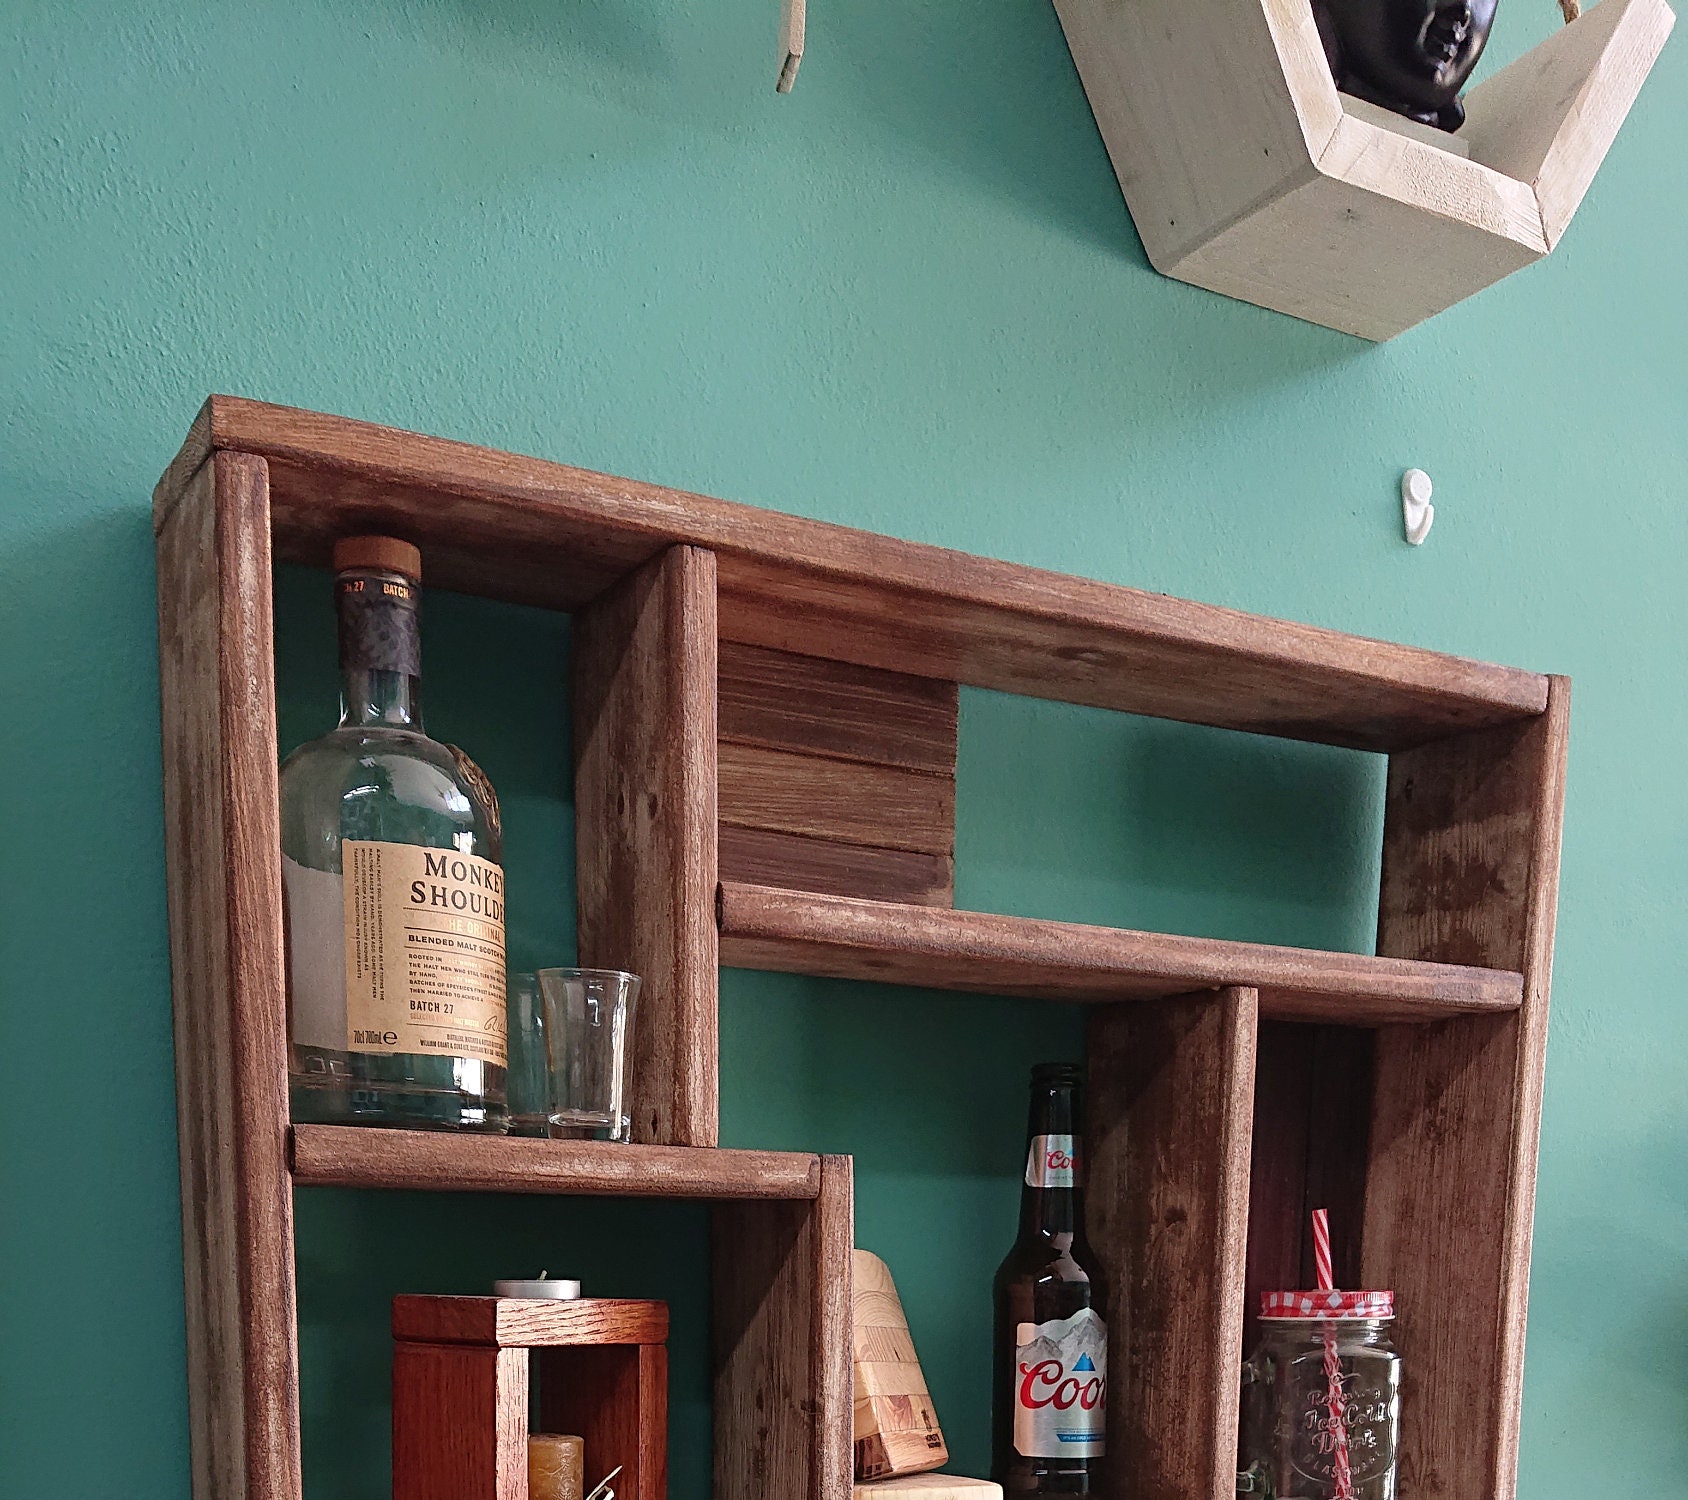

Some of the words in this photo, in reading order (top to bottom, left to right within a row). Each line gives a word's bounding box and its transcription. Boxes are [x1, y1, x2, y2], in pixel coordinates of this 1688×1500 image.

[383, 583, 409, 599] BATCH
[408, 934, 454, 946] BLENDED
[456, 940, 477, 952] MALT
[410, 1000, 440, 1012] BATCH
[444, 1004, 454, 1014] 27
